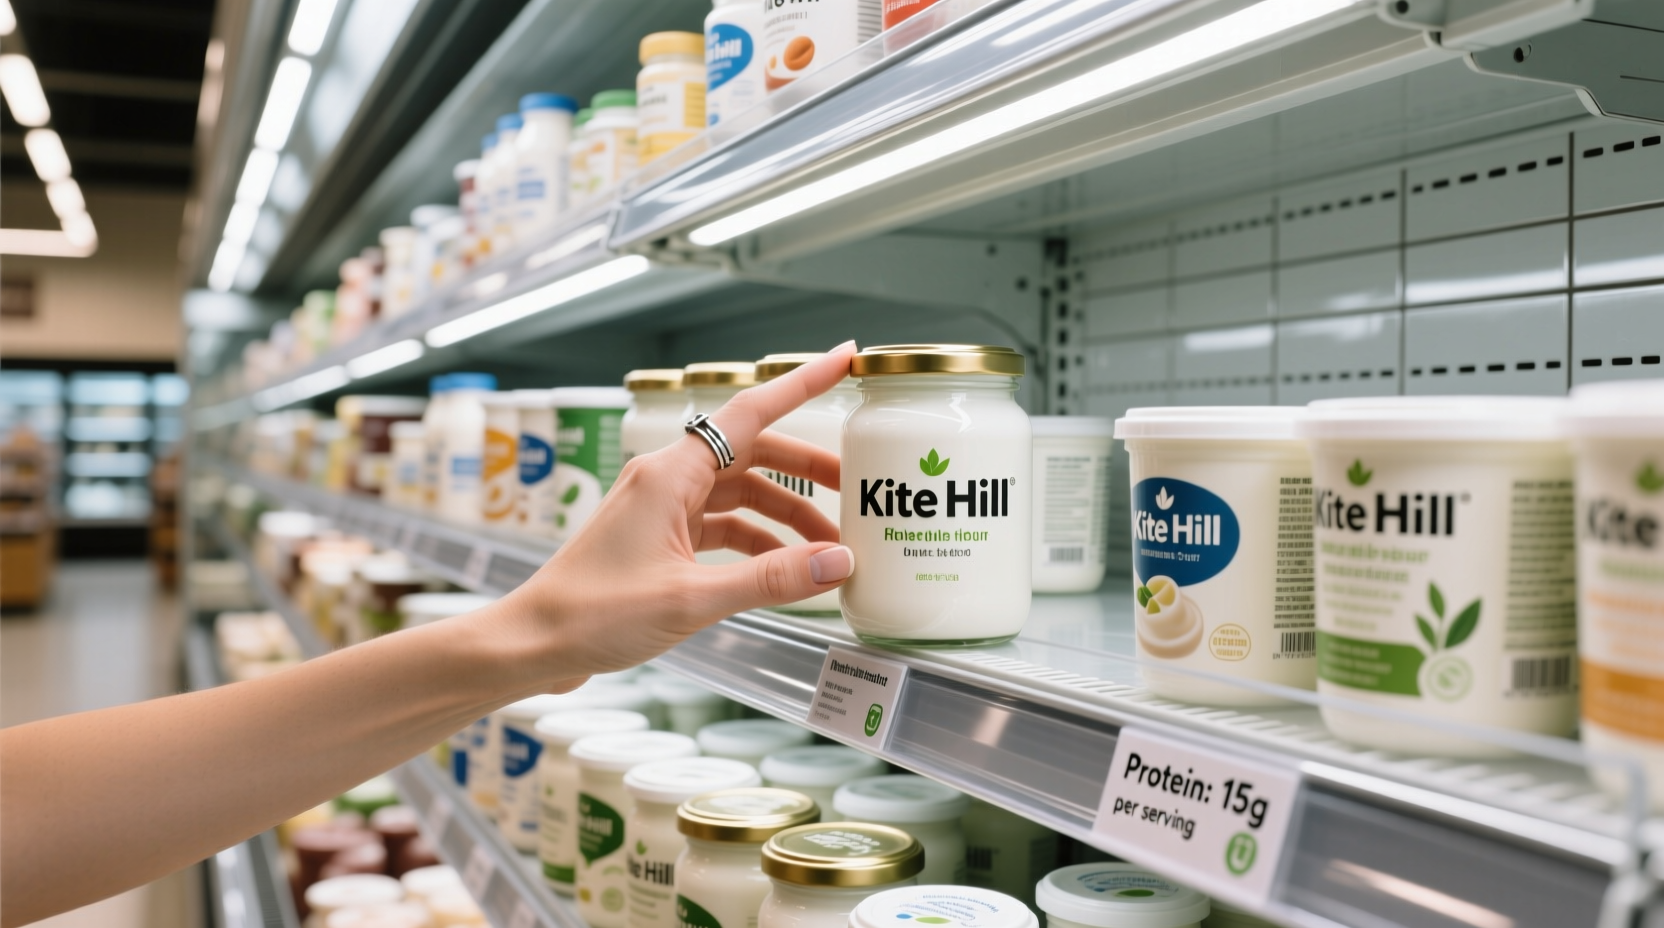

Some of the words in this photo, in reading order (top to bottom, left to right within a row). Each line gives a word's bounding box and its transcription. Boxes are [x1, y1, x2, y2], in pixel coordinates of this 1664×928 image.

[861, 478, 938, 518] Kite
[1133, 510, 1168, 542] Kite
[1172, 514, 1221, 546] Hill
[1124, 753, 1213, 803] Protein:
[1221, 778, 1269, 829] 15g
[1113, 796, 1140, 816] per
[1141, 804, 1196, 840] serving
[645, 859, 675, 887] Hill
